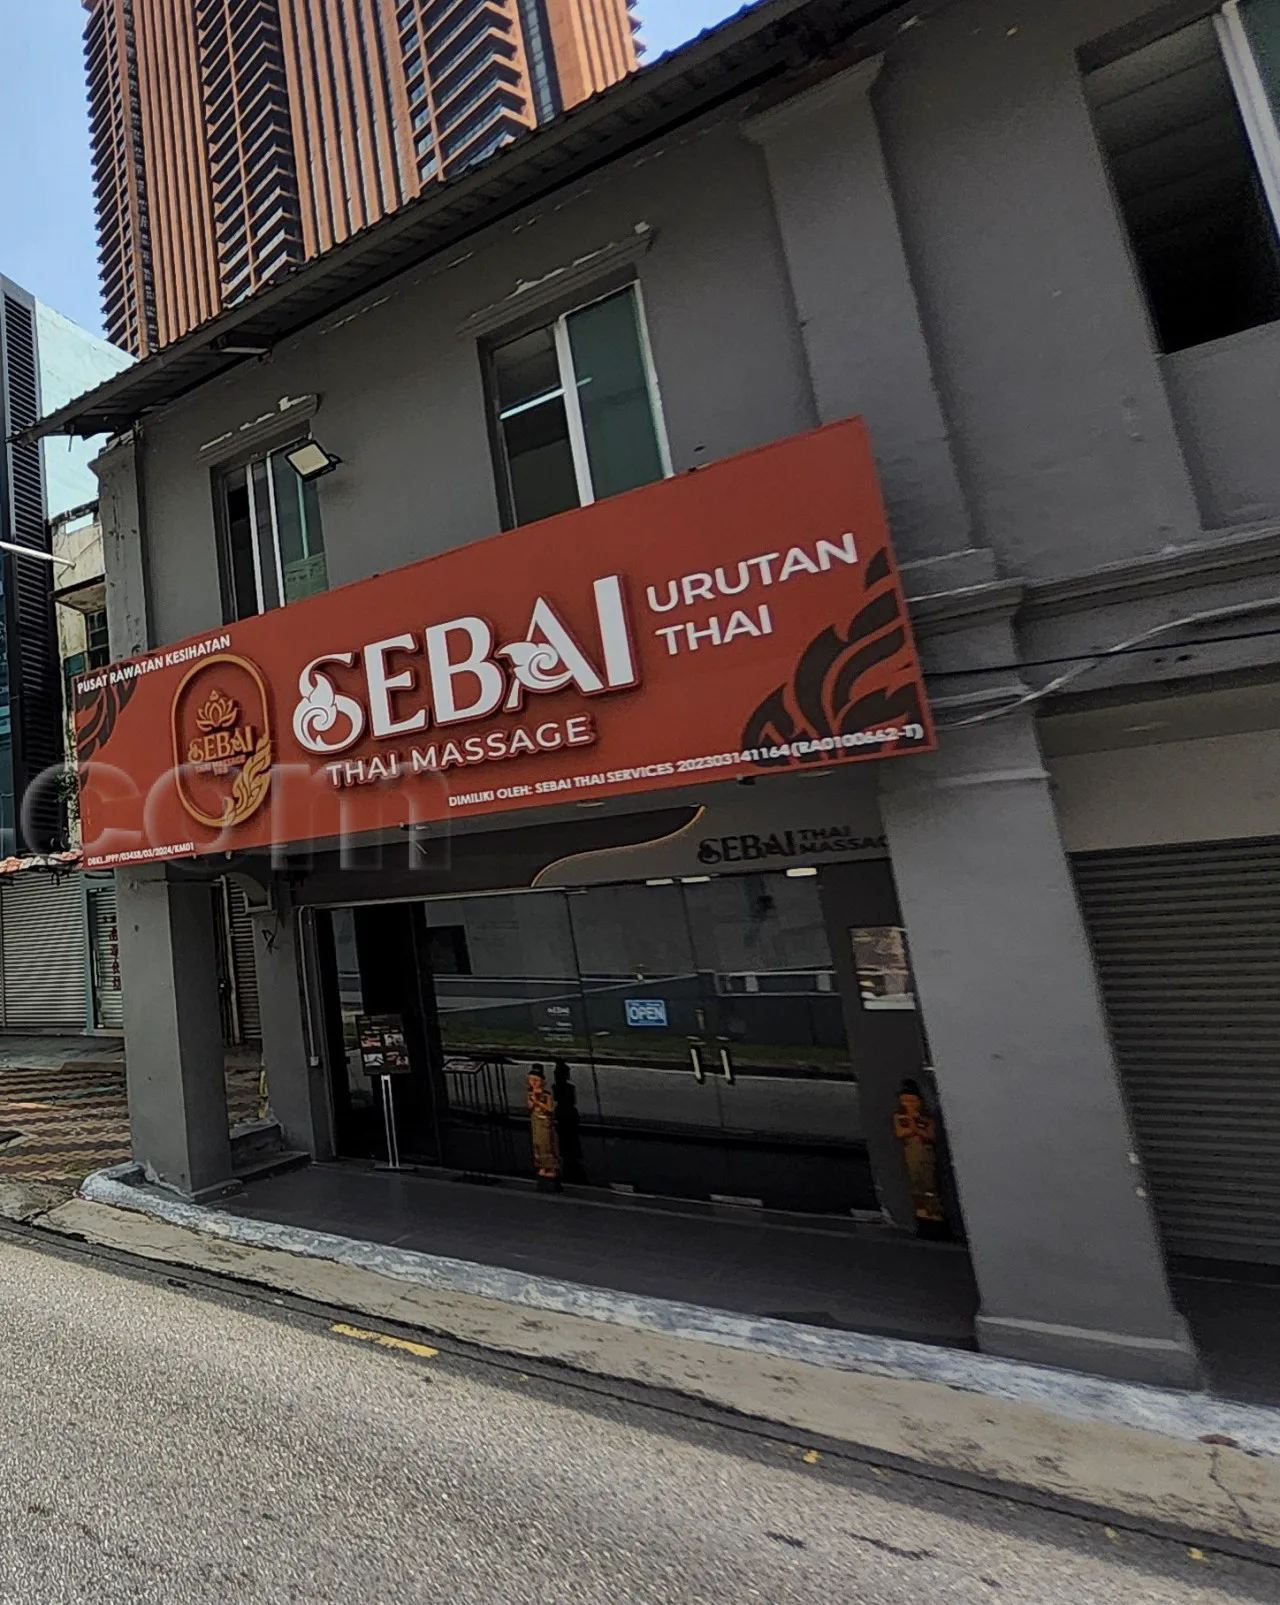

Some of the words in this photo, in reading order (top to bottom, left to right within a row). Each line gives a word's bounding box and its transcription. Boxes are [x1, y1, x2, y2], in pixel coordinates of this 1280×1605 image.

[646, 532, 859, 613] URUTAN
[655, 604, 772, 655] THAI
[77, 673, 108, 695] PUSAT
[109, 655, 163, 684] RAWATAN
[165, 634, 231, 666] KESIHATAN
[292, 575, 636, 752] SEBAI
[188, 725, 253, 764] SEBAI
[326, 754, 397, 787] THAI
[411, 716, 591, 772] MASSAGE
[448, 791, 495, 807] DIMILIKI
[496, 785, 532, 799] OLEH:
[535, 779, 572, 794] SEBAI
[574, 773, 606, 788] THAI
[607, 762, 675, 783] SERVICES
[697, 830, 796, 865] SEBAI
[630, 1006, 664, 1020] OPEN
